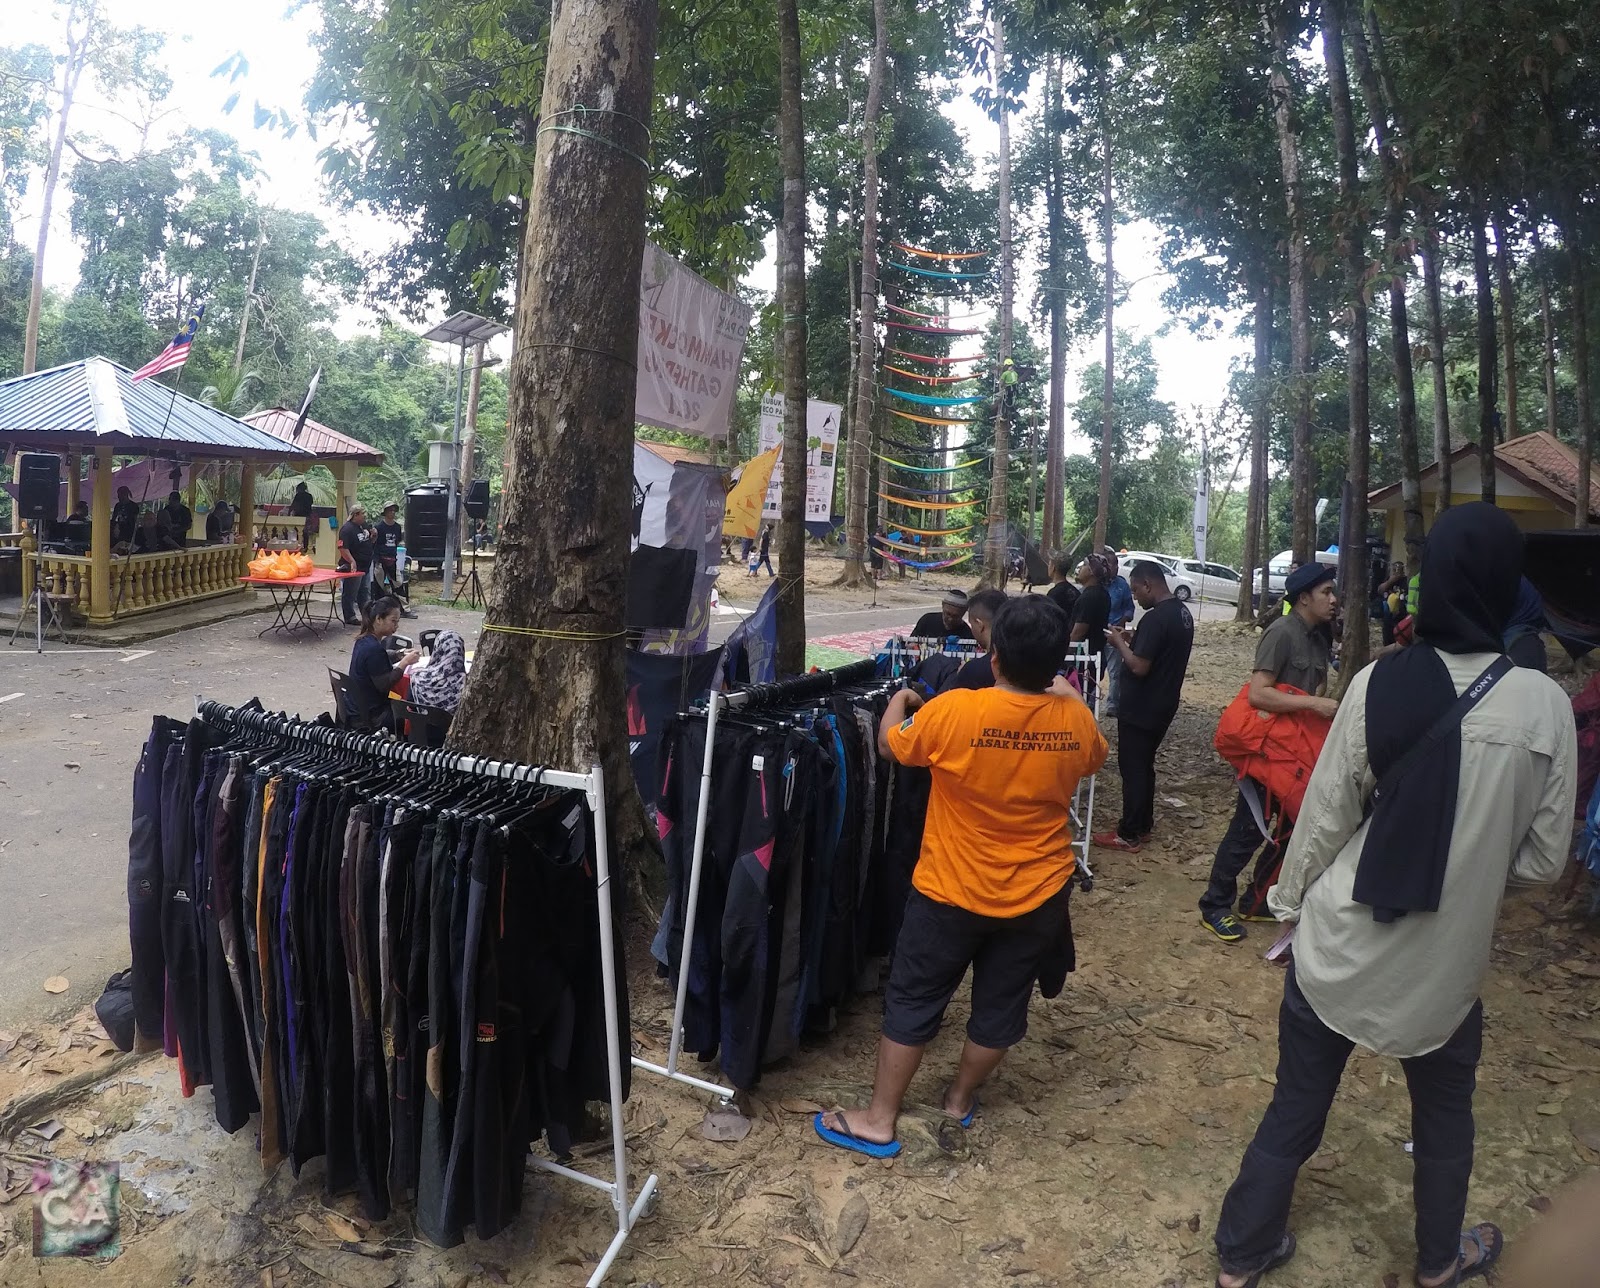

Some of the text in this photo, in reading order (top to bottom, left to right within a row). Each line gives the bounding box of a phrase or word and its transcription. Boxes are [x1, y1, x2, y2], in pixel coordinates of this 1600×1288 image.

[762, 406, 774, 414] ECO
[1469, 673, 1493, 699] SONY
[982, 728, 1073, 741] KELAB AKTIVITI
[970, 738, 1080, 752] LASAK KENYALANG
